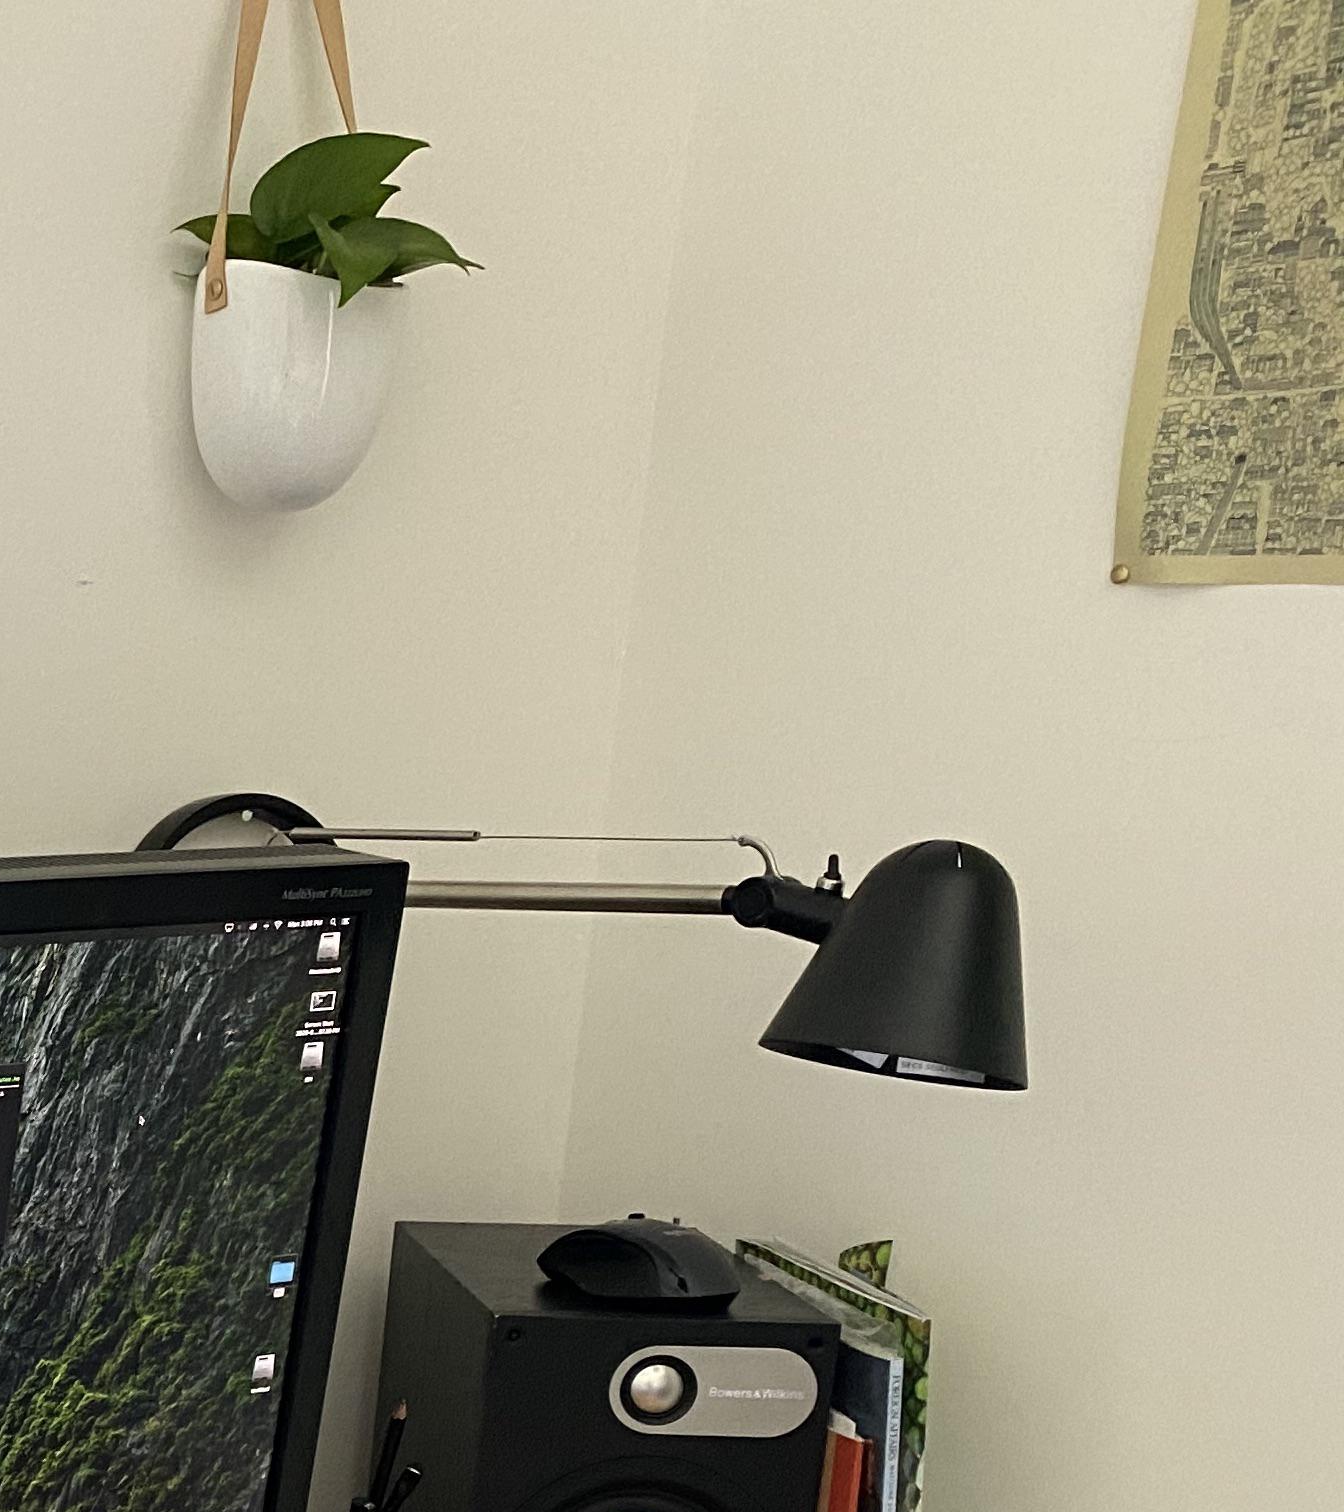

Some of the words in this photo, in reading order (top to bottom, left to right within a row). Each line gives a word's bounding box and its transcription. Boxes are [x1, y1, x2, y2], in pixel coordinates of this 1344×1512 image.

[709, 1387, 752, 1398] Bowers
[889, 1375, 901, 1420] FOREIGN
[887, 1423, 899, 1462] AFFAIRS
